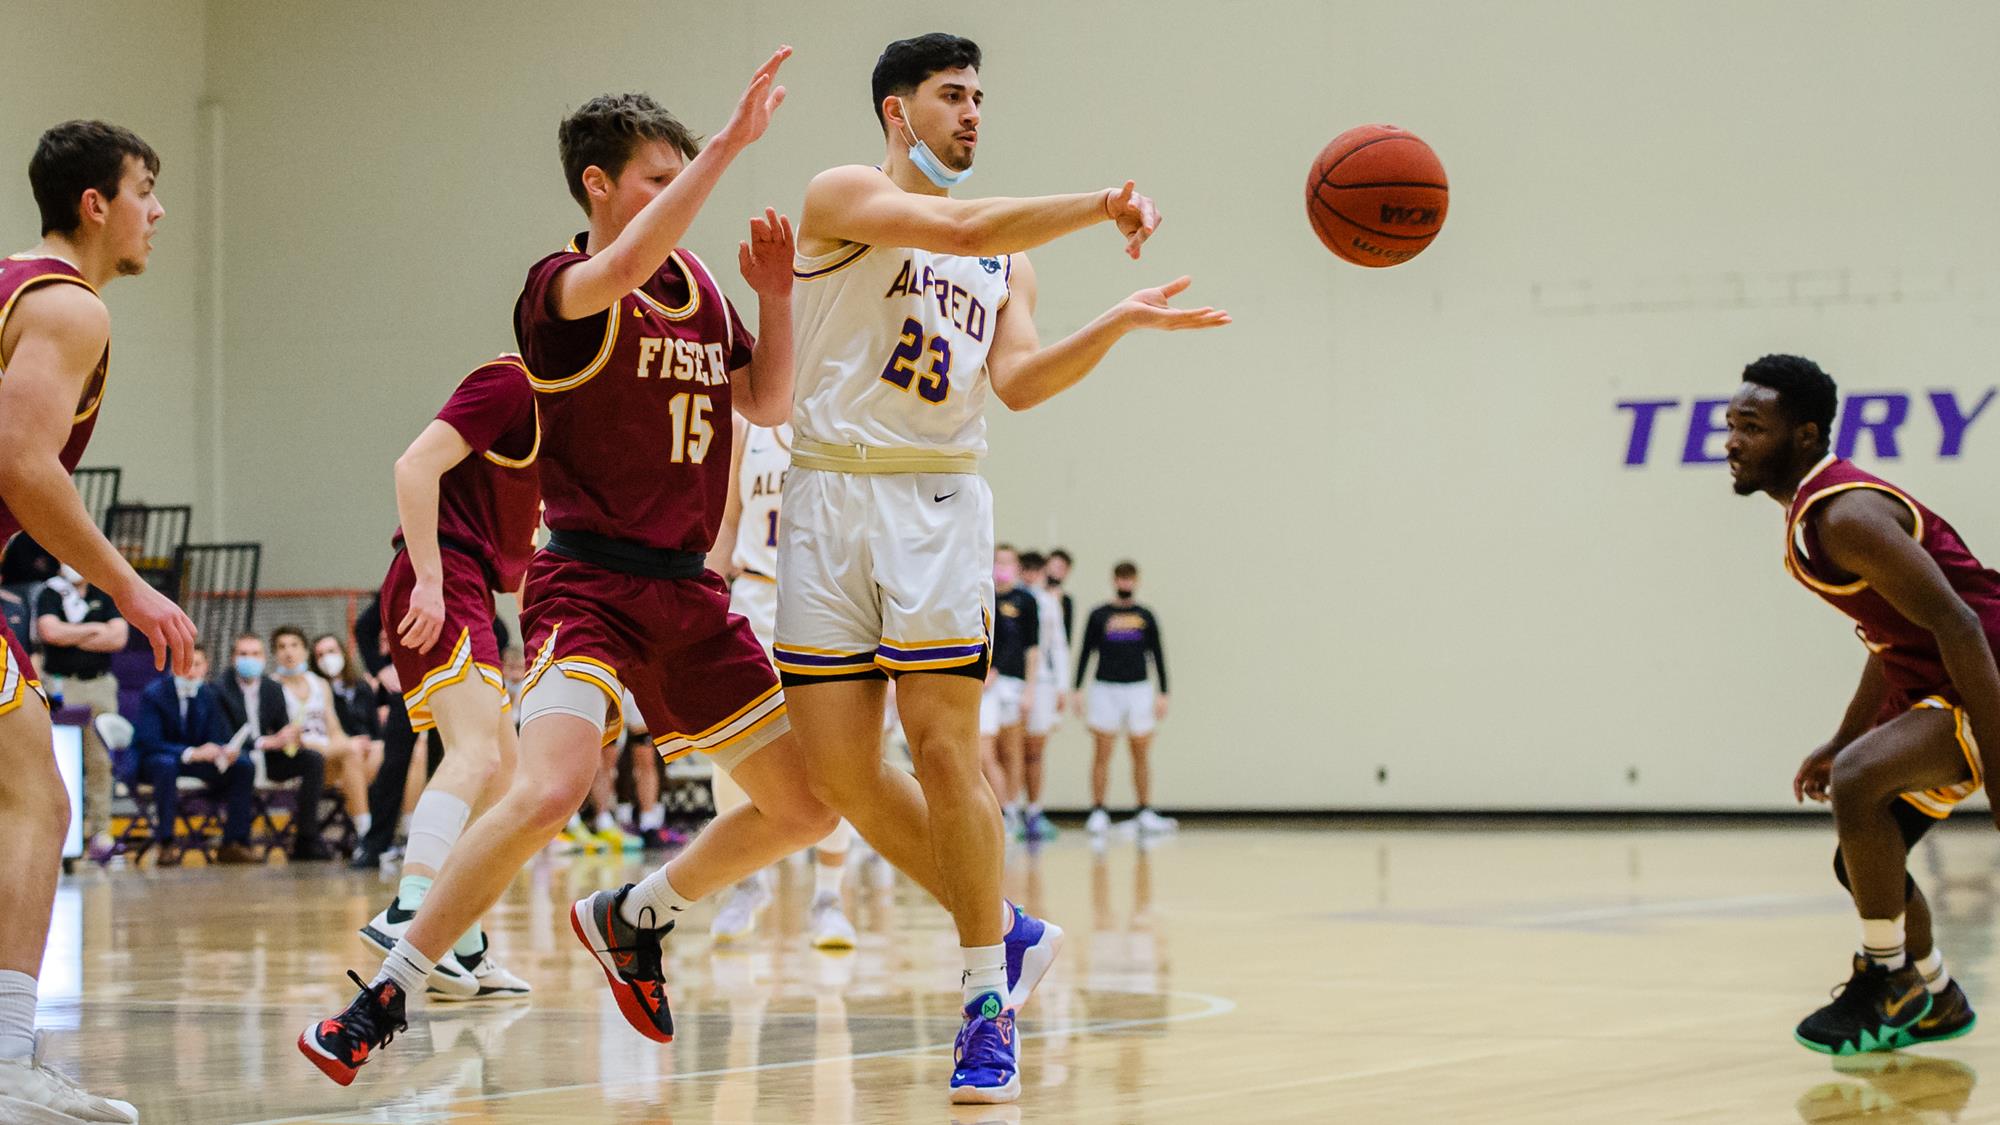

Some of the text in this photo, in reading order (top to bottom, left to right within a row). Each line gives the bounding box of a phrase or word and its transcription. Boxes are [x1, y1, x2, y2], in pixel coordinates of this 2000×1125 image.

[885, 258, 986, 342] ALFRED
[880, 316, 951, 405] 23
[668, 391, 714, 464] 15
[1616, 386, 1997, 465] TERY
[751, 471, 787, 499] ALF
